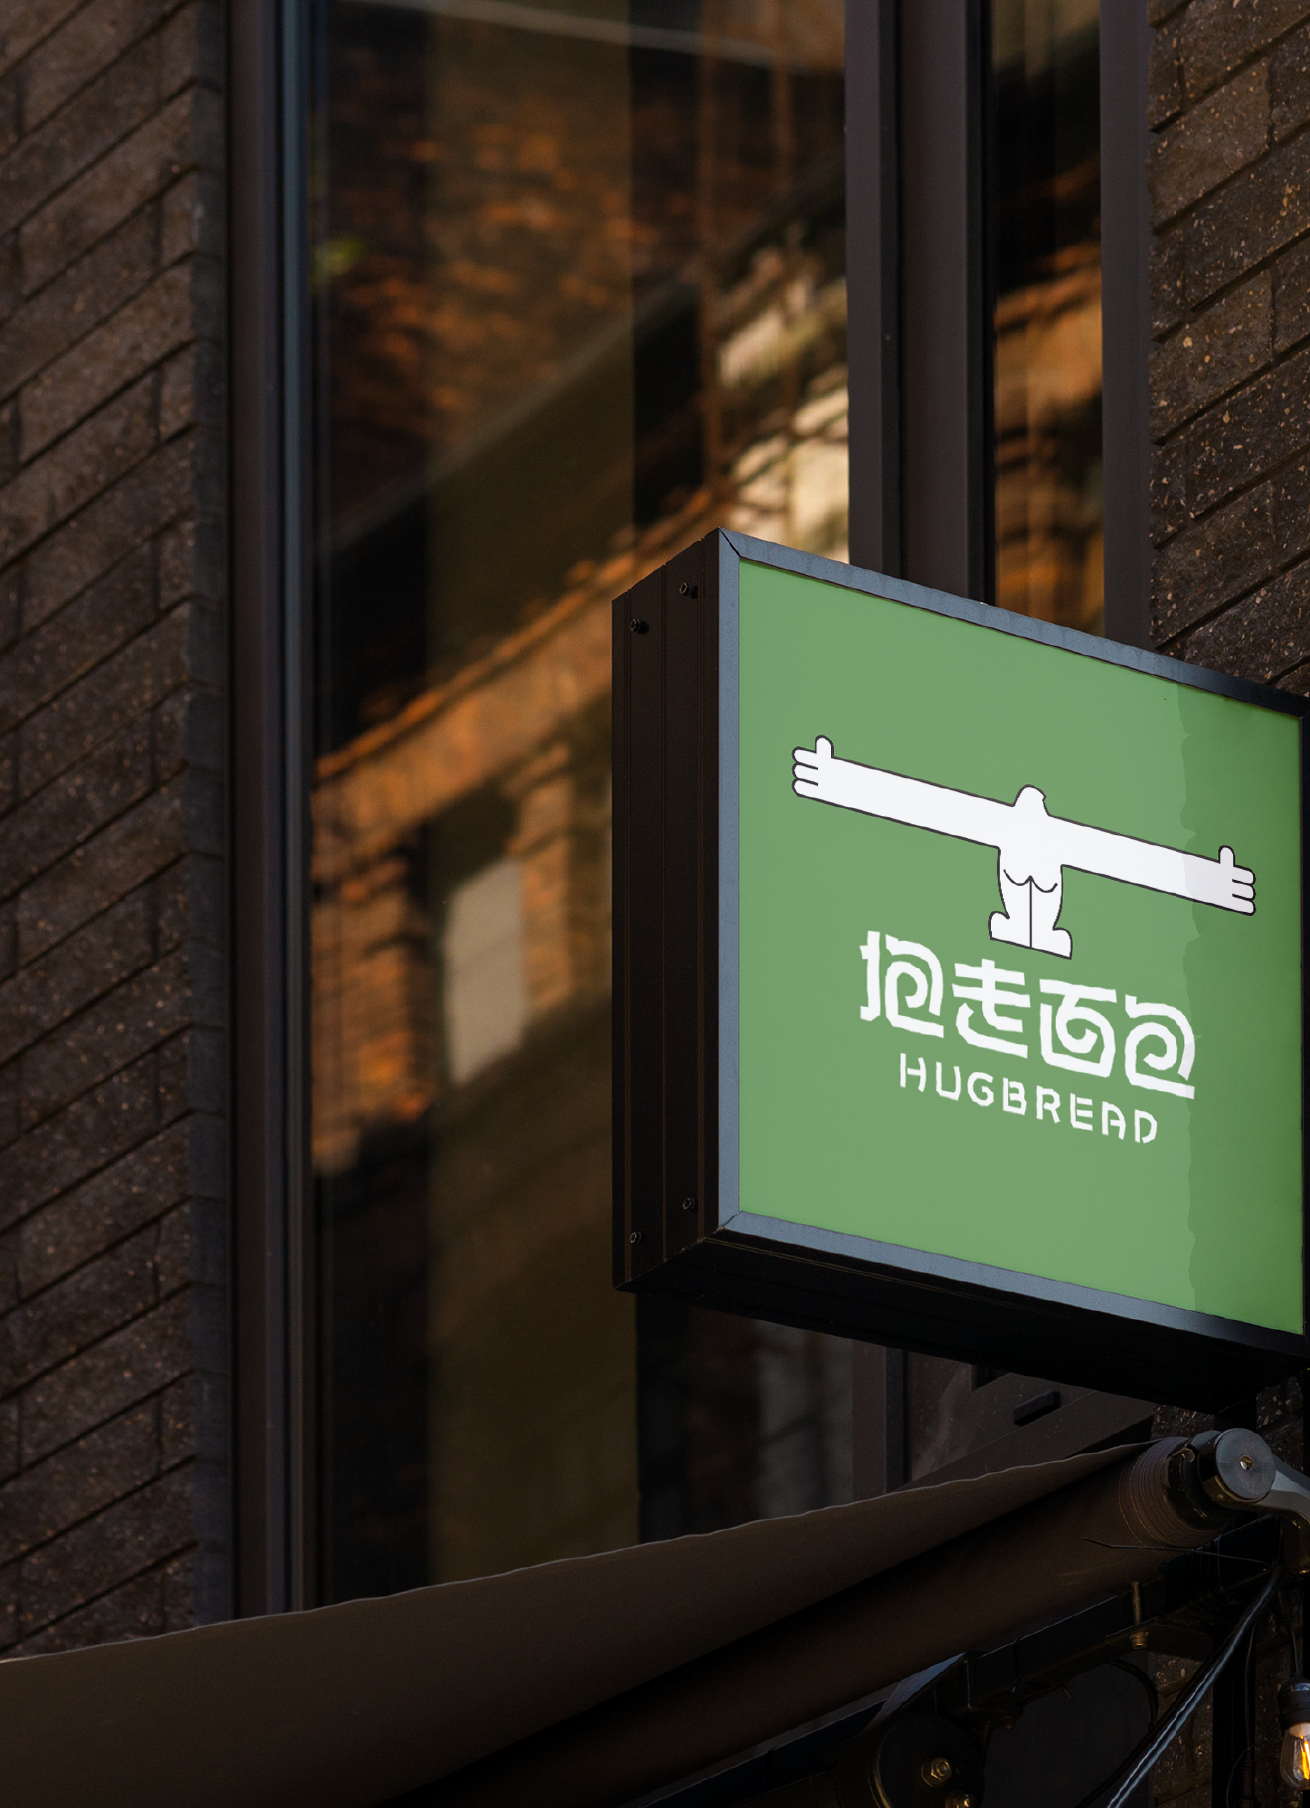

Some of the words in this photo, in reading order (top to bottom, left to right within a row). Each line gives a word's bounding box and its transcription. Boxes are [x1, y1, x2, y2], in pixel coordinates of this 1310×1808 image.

[859, 930, 1196, 1100] 抱走面包
[899, 1052, 1159, 1144] HUGBREAD
